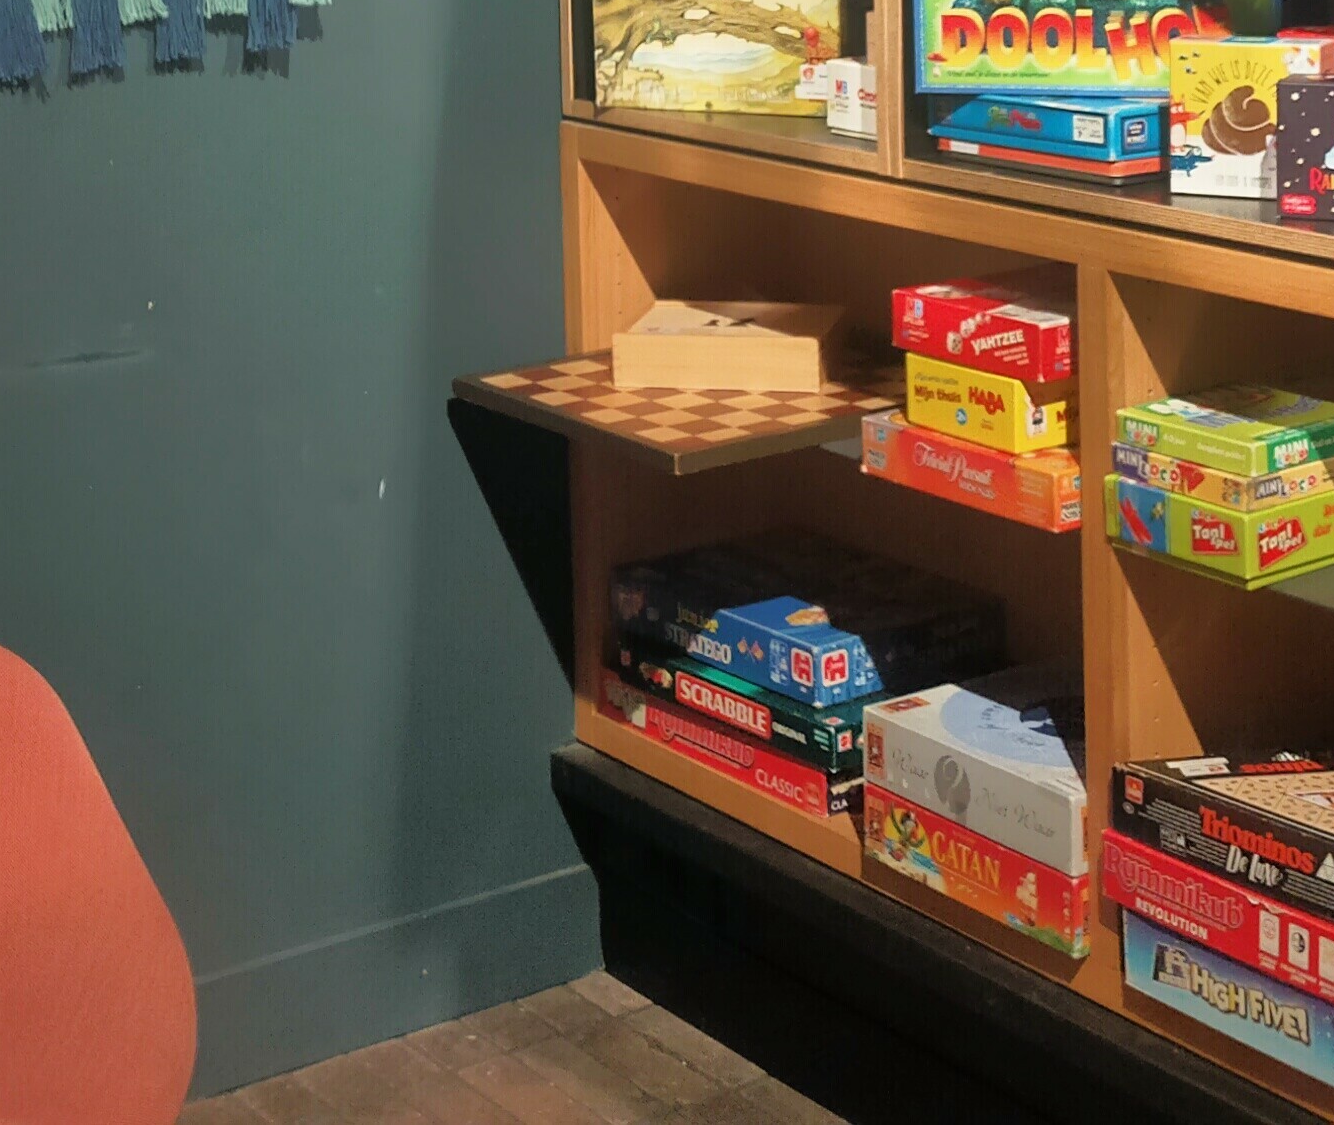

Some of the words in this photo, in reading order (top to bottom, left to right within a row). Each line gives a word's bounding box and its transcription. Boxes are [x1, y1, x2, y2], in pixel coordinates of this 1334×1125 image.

[969, 386, 1006, 415] HABA
[1274, 439, 1309, 460] MINI
[666, 624, 733, 665] STRATEGO
[678, 678, 768, 735] SCRABBLE
[754, 768, 804, 803] CLASSIC
[931, 830, 1001, 890] CATAN
[1198, 804, 1316, 875] Triominos
[1135, 897, 1209, 941] REVOLUTION
[1189, 962, 1248, 1019] HIGH
